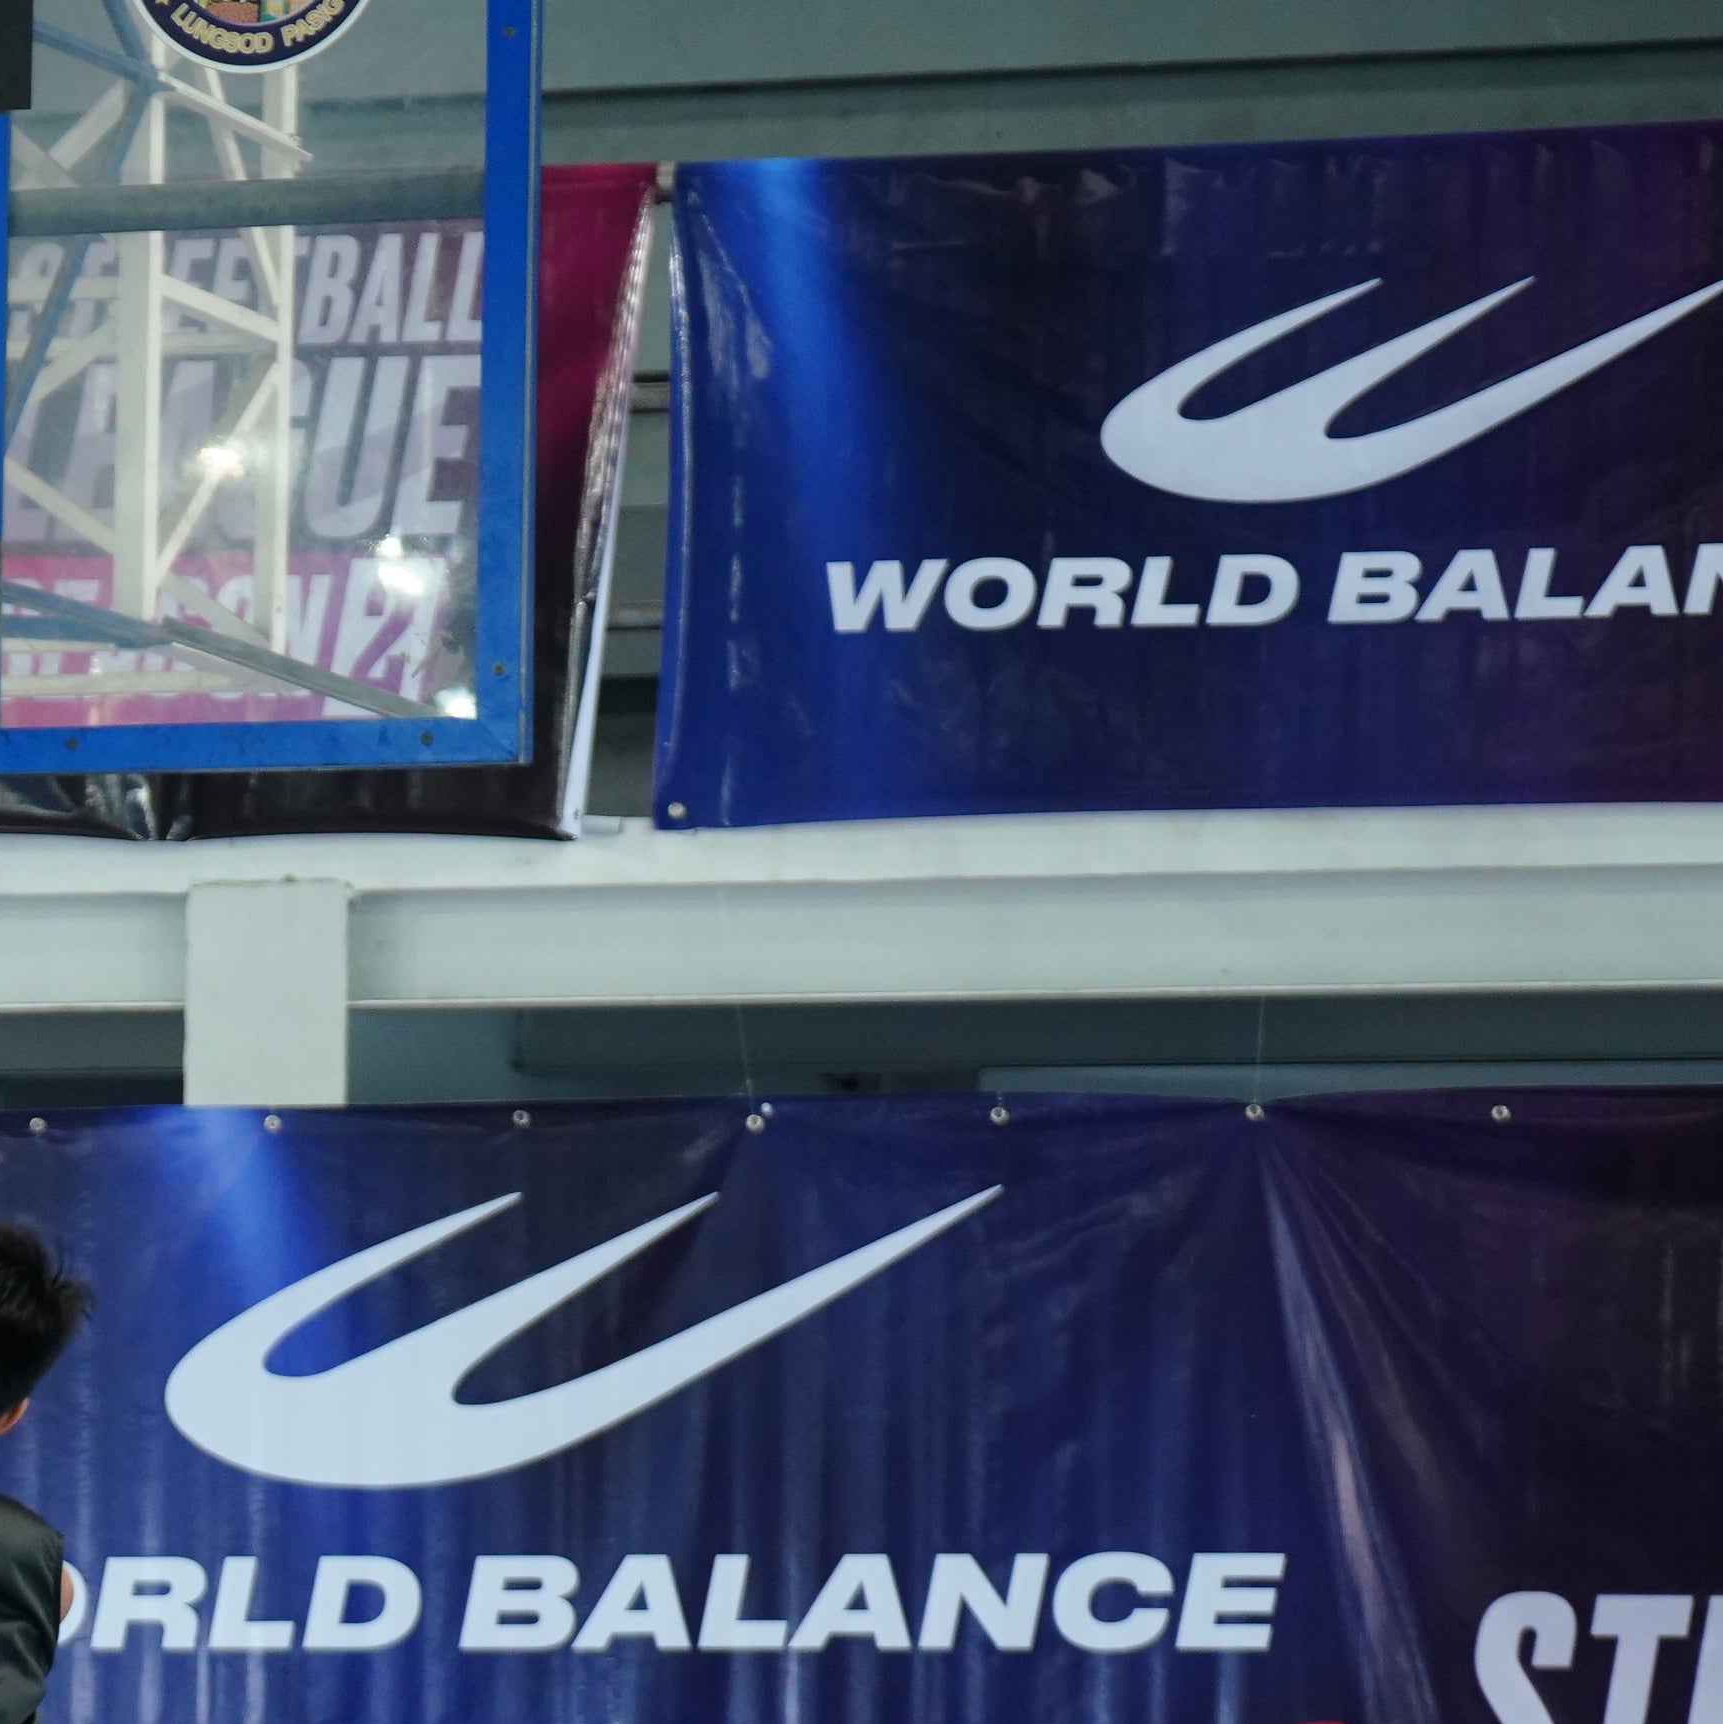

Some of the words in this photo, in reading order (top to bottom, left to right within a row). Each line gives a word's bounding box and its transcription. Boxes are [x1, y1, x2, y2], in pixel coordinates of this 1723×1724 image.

[170, 3, 274, 54] LUNGSOD
[280, 0, 345, 47] PASIG
[826, 553, 1302, 632] WORLD
[458, 1551, 1288, 1653] BALANCE
